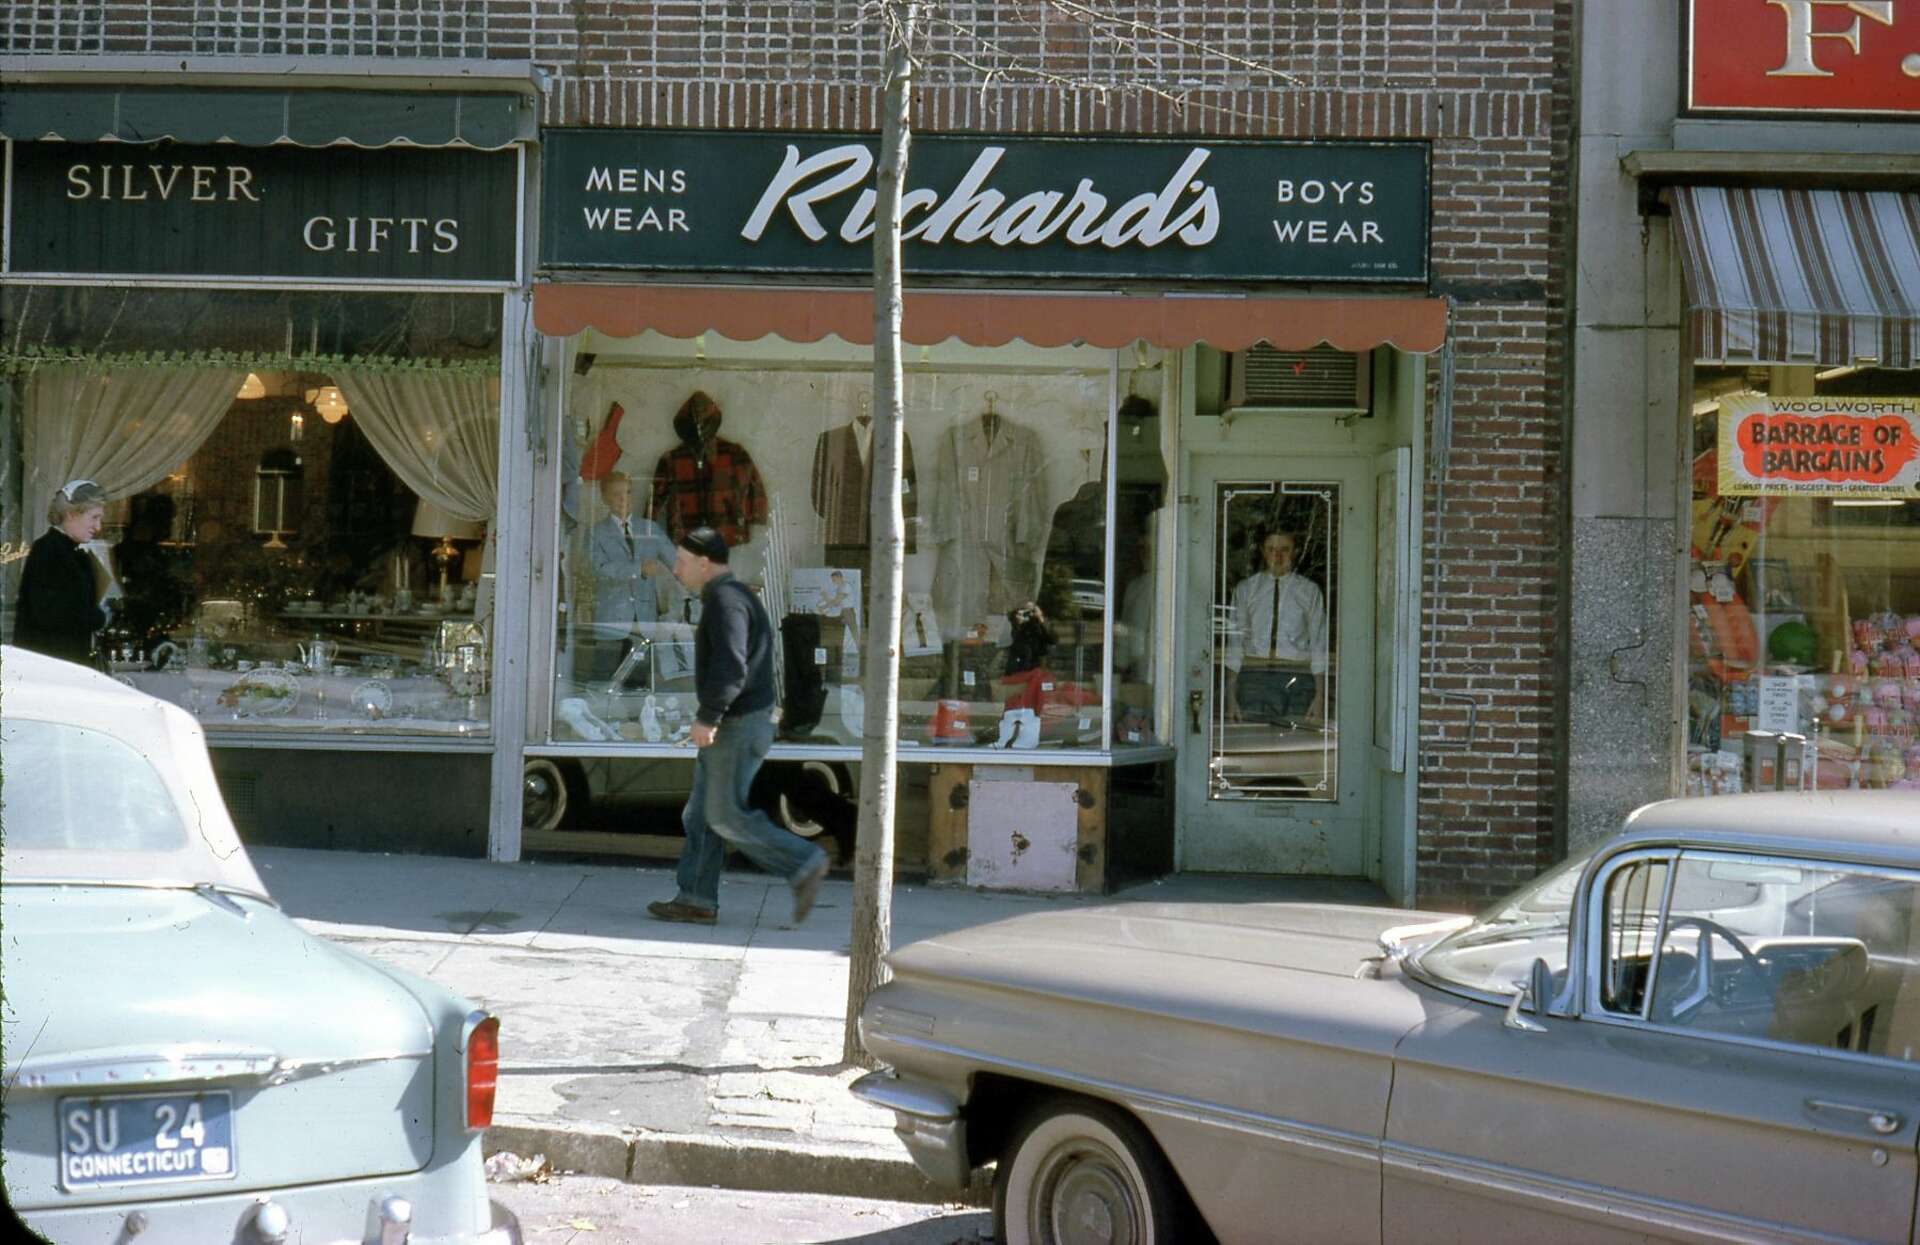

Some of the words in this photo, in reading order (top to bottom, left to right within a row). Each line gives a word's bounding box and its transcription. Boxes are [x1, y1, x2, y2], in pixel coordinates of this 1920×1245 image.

[66, 165, 260, 202] SILVER
[584, 166, 687, 194] MENS
[1278, 180, 1375, 205] BOYS
[740, 143, 1221, 249] Richard's
[583, 207, 690, 232] WEAR
[1273, 220, 1384, 244] WEAR
[303, 216, 459, 254] GIFTS
[1771, 400, 1915, 413] WOOLWORTH
[1751, 422, 1861, 446] BARRAGE
[1874, 424, 1902, 446] OF
[1762, 448, 1884, 474] BARGAINS
[67, 1108, 119, 1153] SU
[154, 1102, 206, 1149] 24
[68, 1149, 197, 1179] CONNECTICUT
